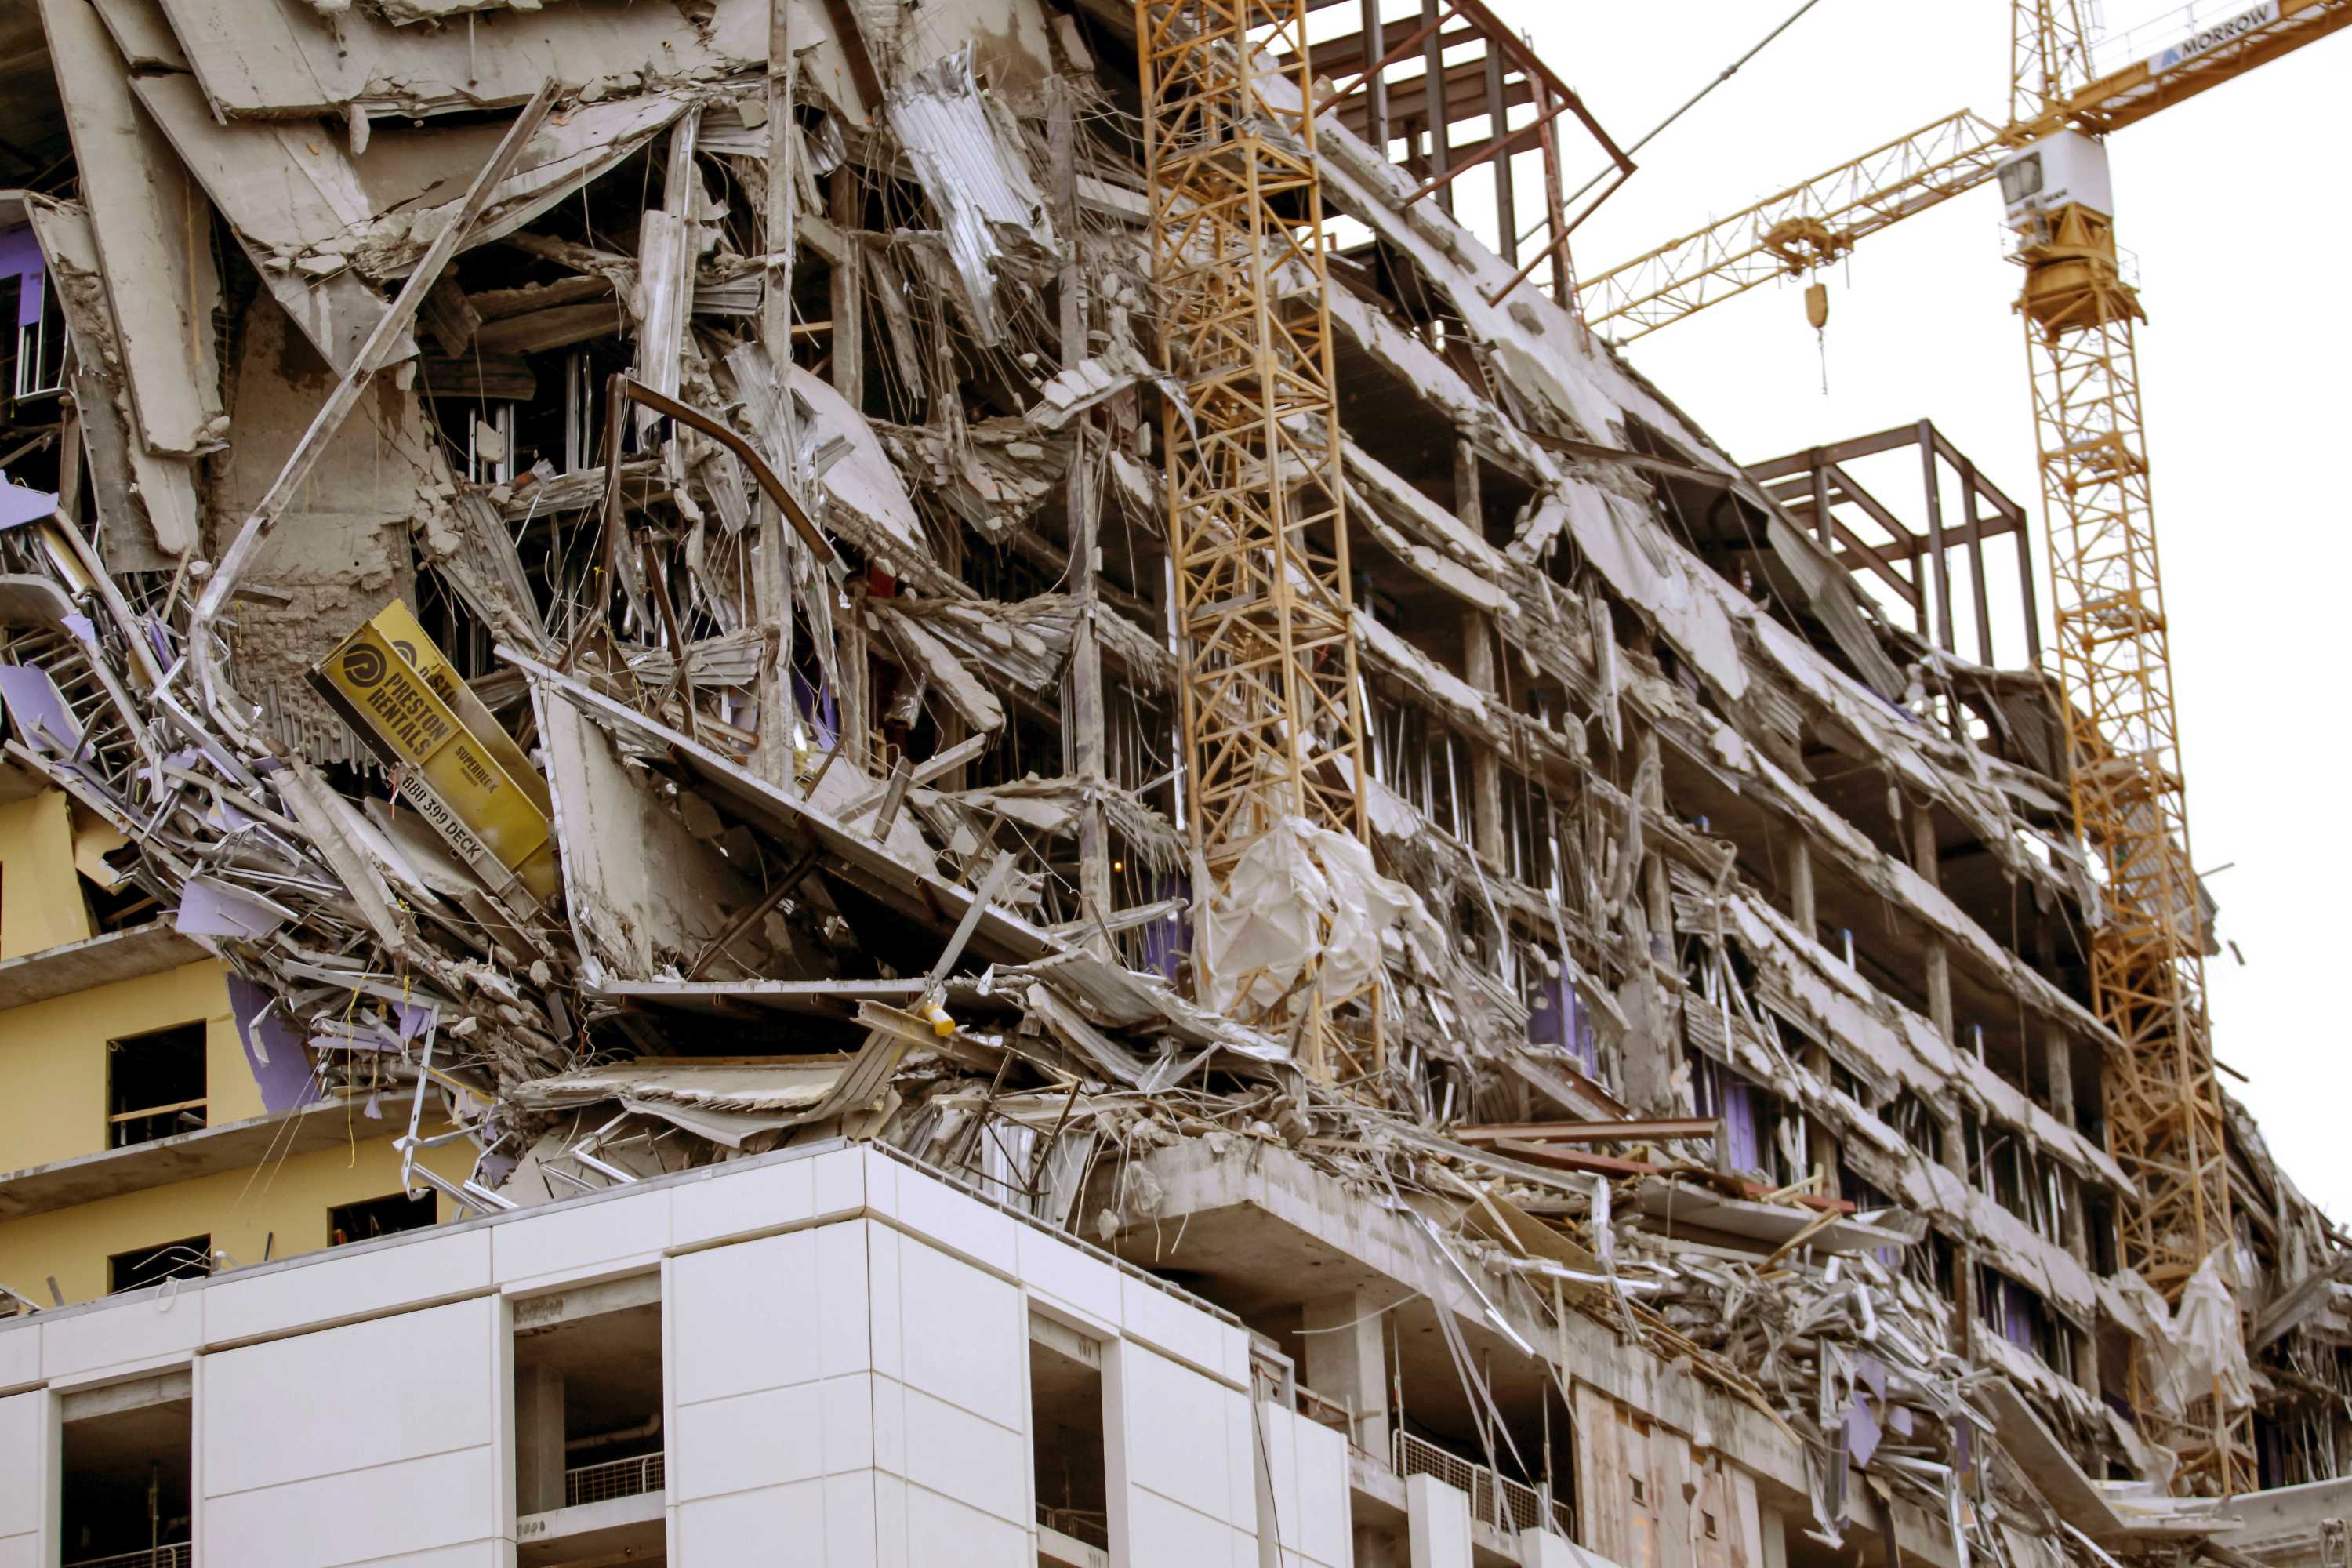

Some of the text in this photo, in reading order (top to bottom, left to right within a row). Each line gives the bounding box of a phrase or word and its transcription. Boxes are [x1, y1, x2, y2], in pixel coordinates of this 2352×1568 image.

[2182, 5, 2269, 57] MORROW
[367, 687, 431, 756] RENTALS
[384, 672, 449, 742] PRESTON
[456, 746, 499, 794] SUPERDECK
[402, 775, 481, 858] 888 399 DECK
